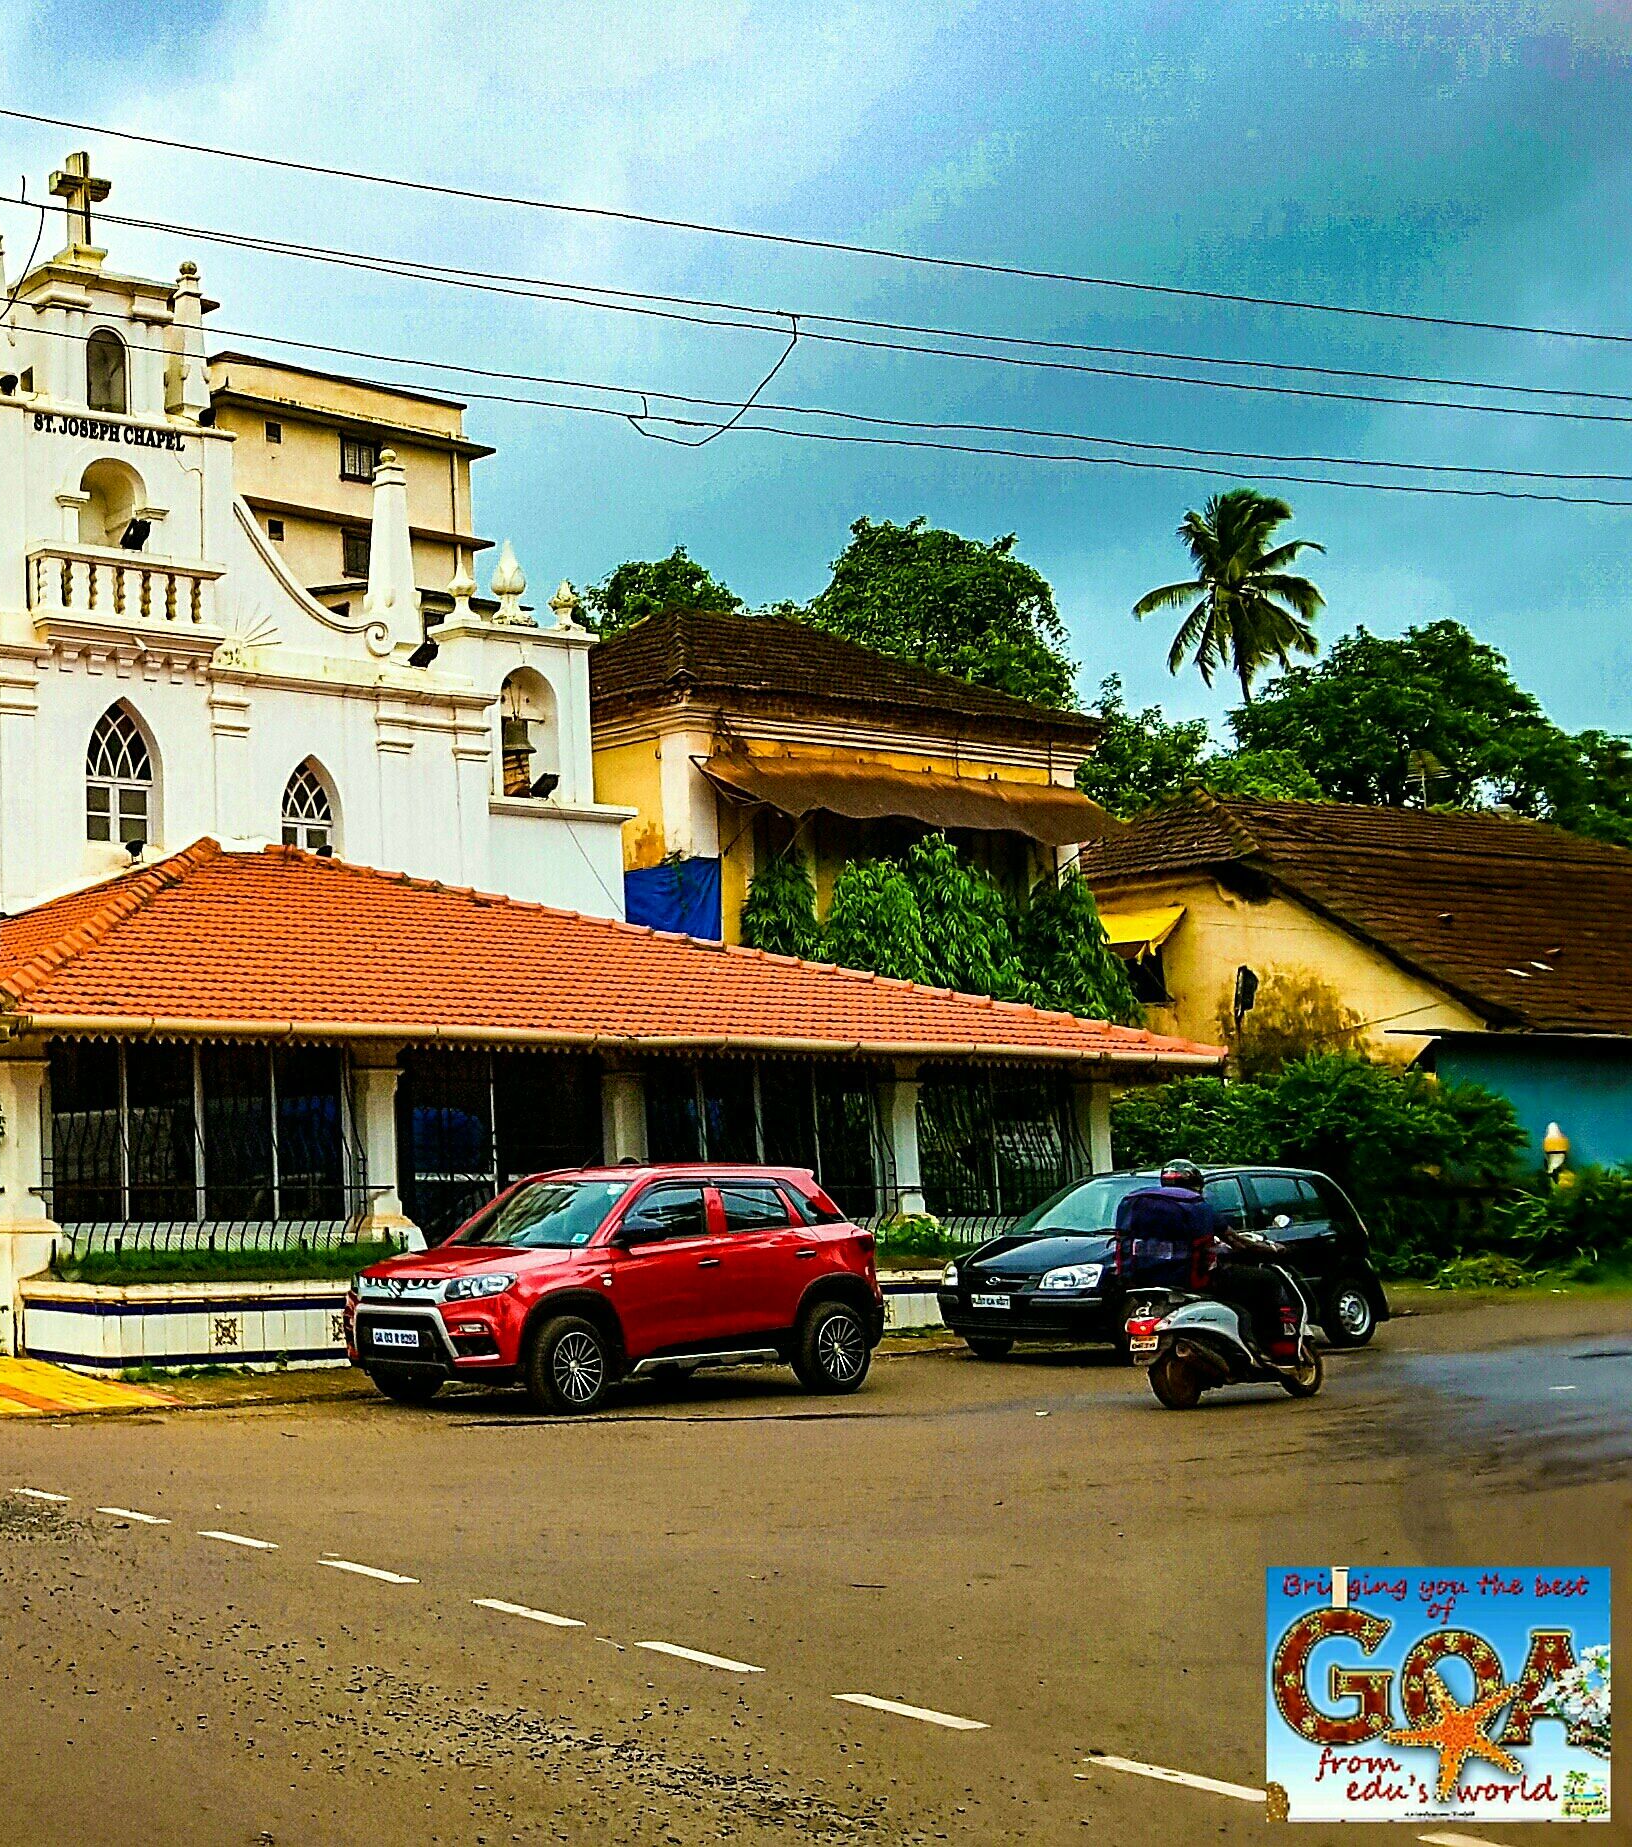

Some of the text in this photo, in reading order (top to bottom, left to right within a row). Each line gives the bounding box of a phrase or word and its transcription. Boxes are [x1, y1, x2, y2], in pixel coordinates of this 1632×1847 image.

[34, 413, 185, 451] ST. JOSEPH CHAPEL
